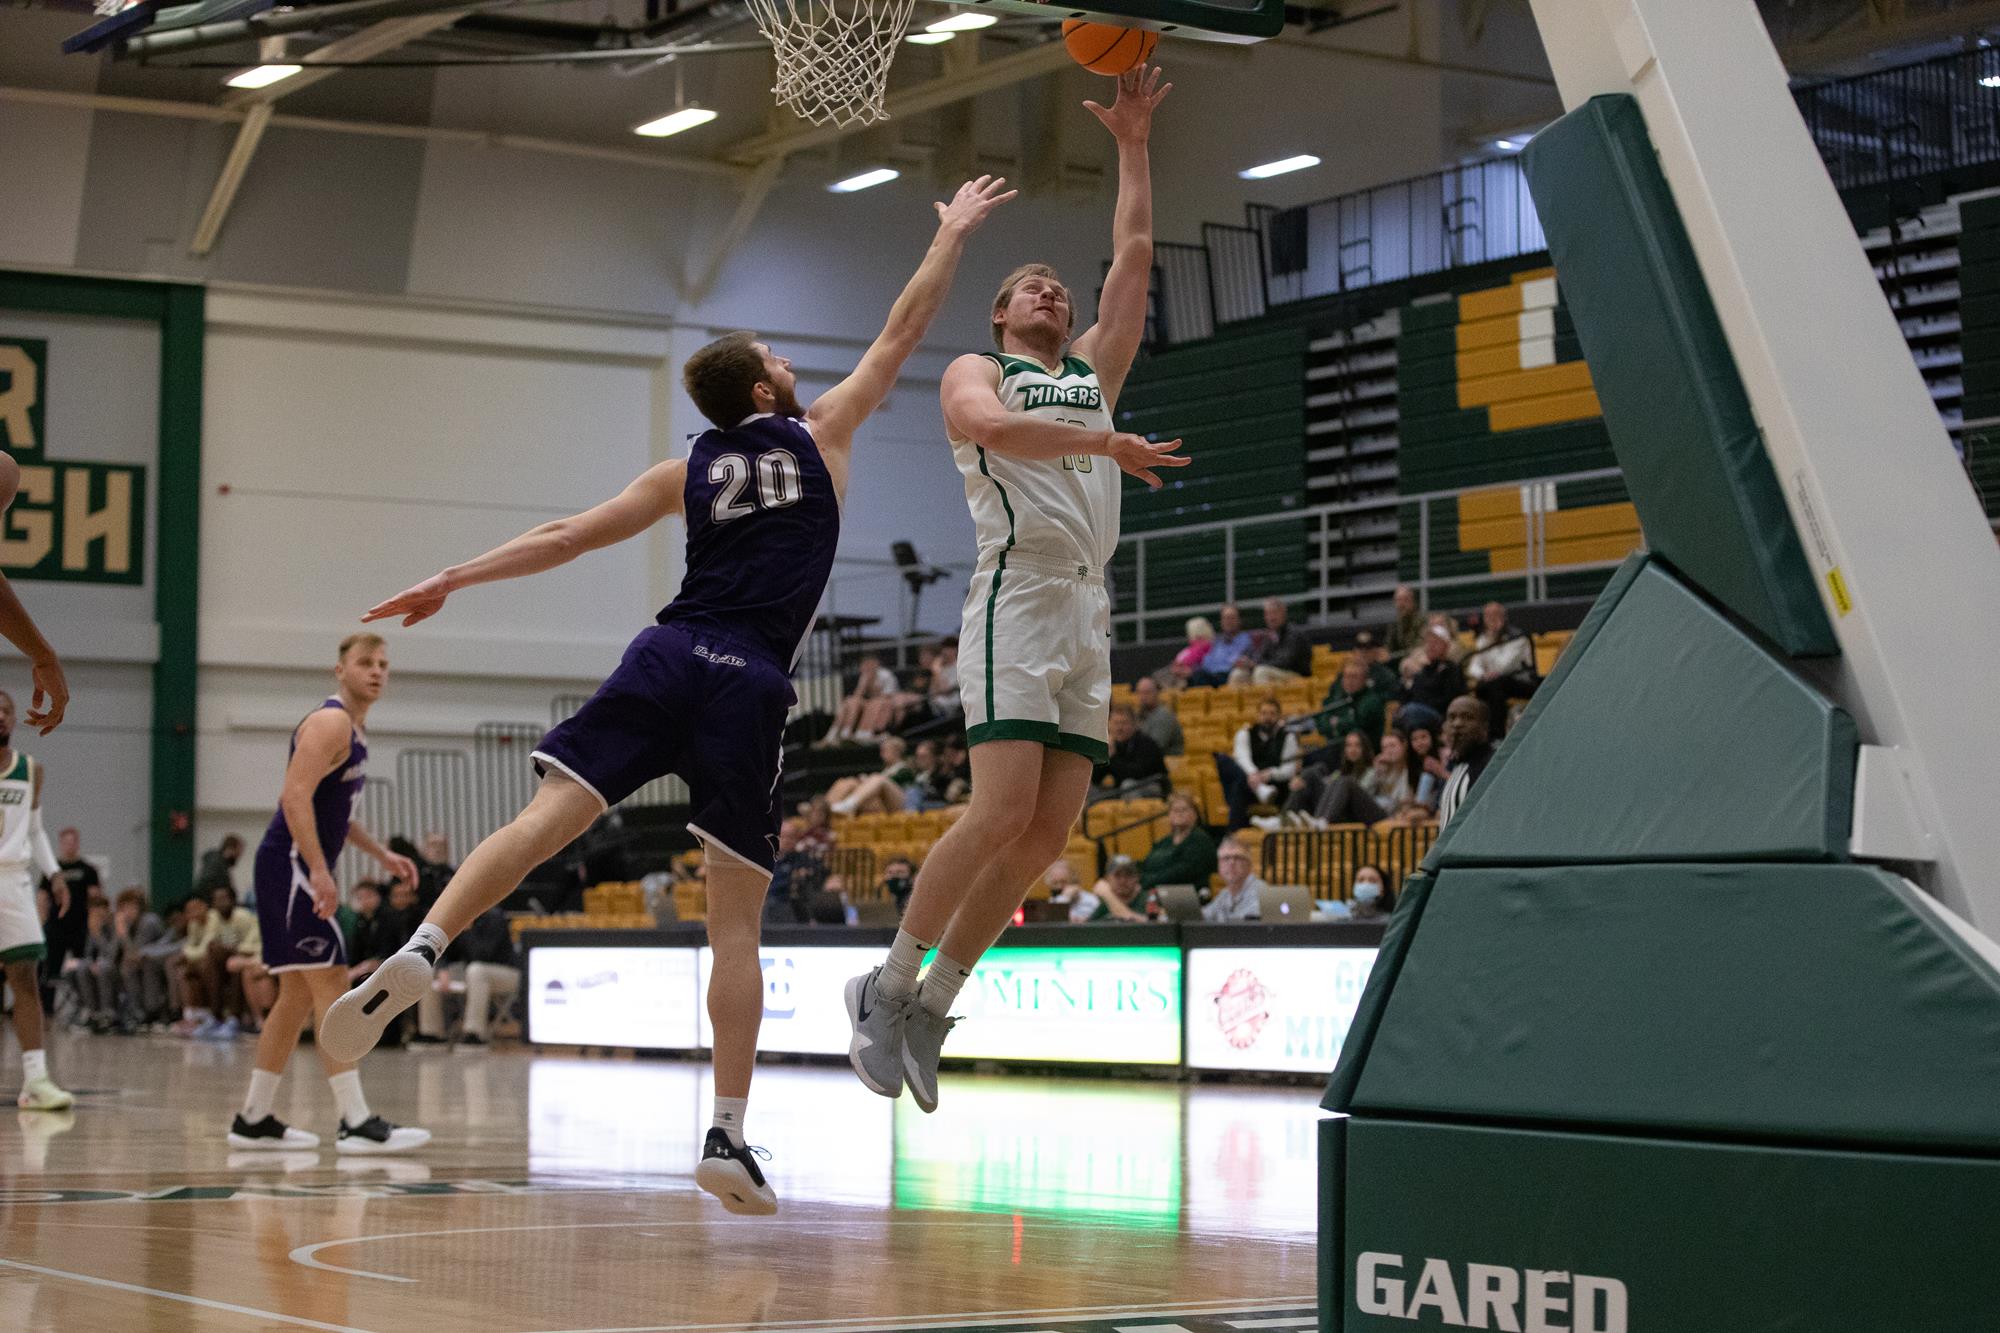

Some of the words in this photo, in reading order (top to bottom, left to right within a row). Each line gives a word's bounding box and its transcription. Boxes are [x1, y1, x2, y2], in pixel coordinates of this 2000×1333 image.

[1025, 385, 1100, 407] MINERS
[0, 464, 132, 573] GH
[708, 448, 803, 524] 20
[1356, 1251, 1628, 1333] GARED
